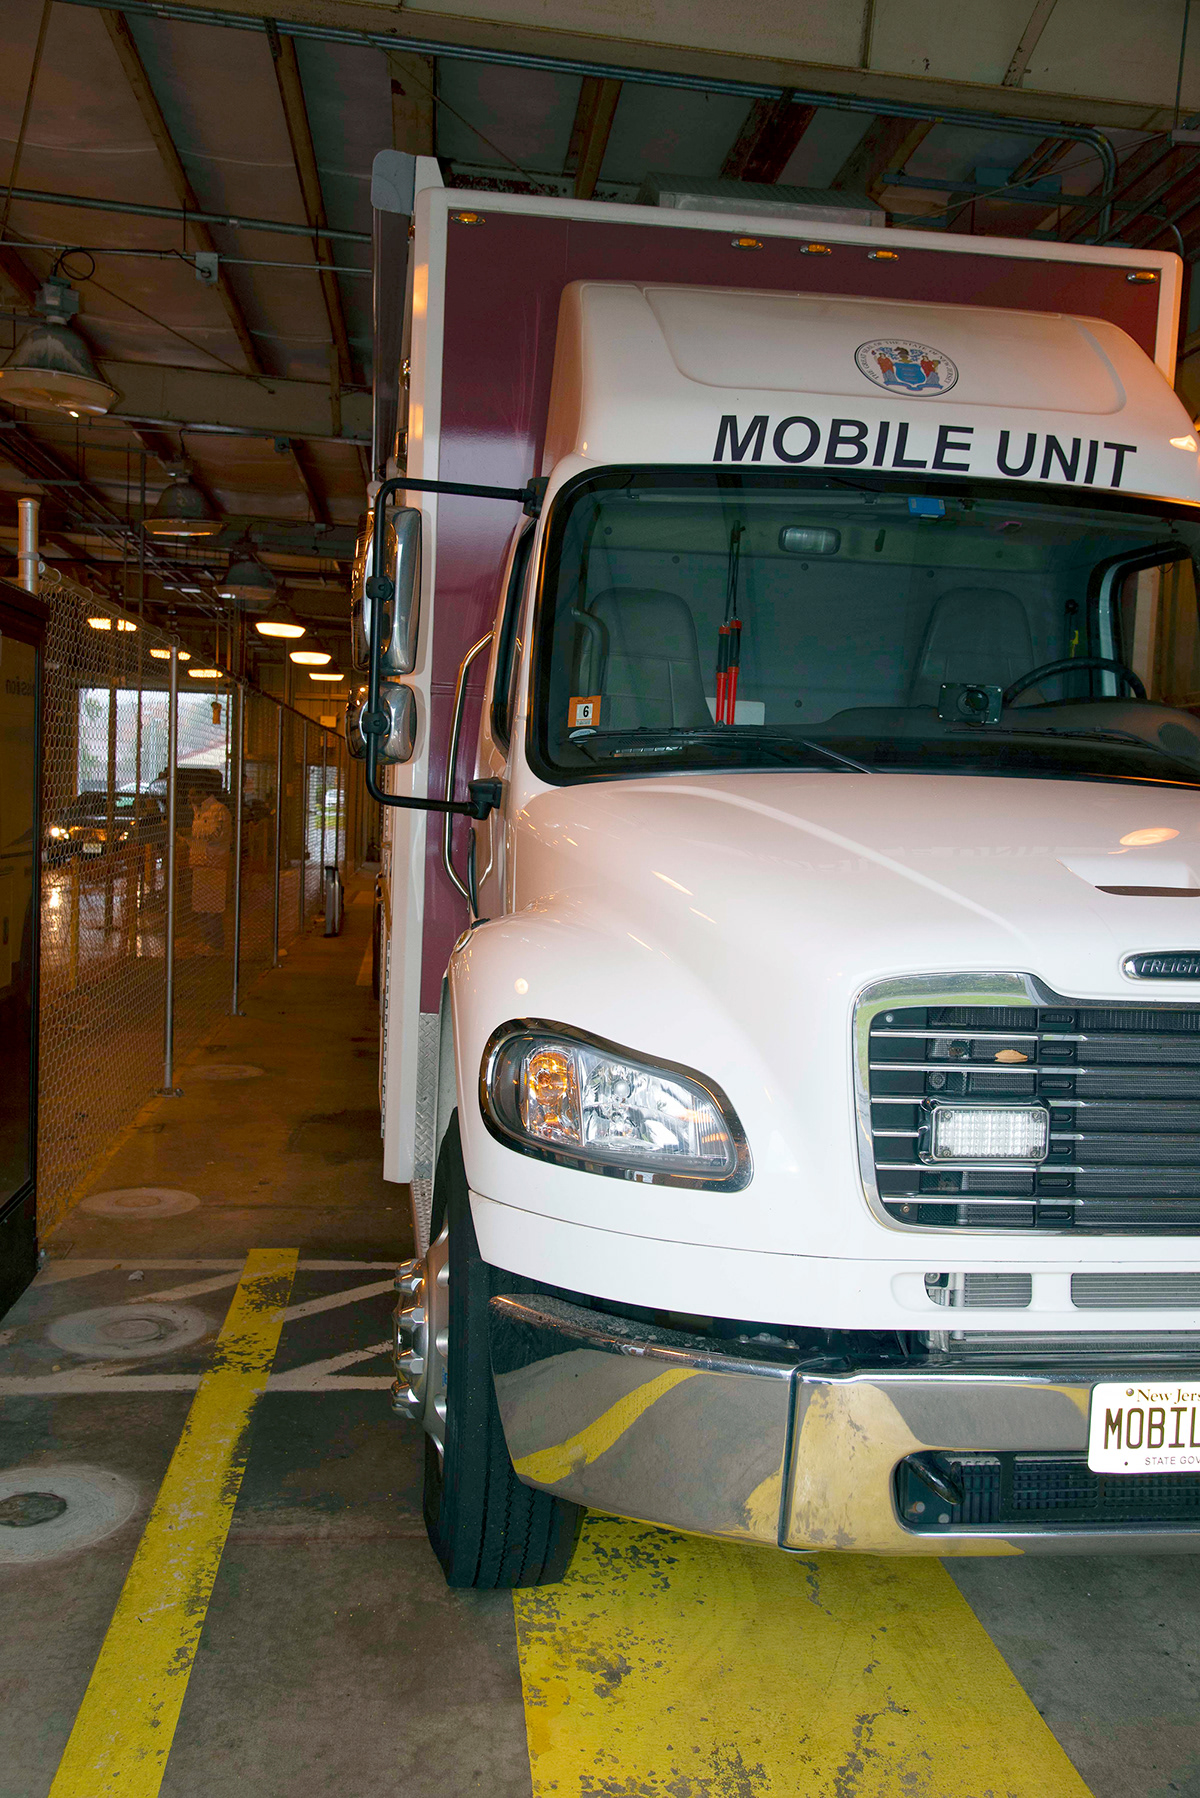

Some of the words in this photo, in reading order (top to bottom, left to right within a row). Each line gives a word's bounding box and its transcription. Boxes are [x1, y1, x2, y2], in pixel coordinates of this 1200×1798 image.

[713, 415, 974, 472] MOBILE
[997, 430, 1137, 487] UNIT
[582, 705, 590, 718] 6
[1137, 1389, 1172, 1402] New
[1104, 1407, 1200, 1449] MOBIL
[1145, 1456, 1176, 1465] STATE
